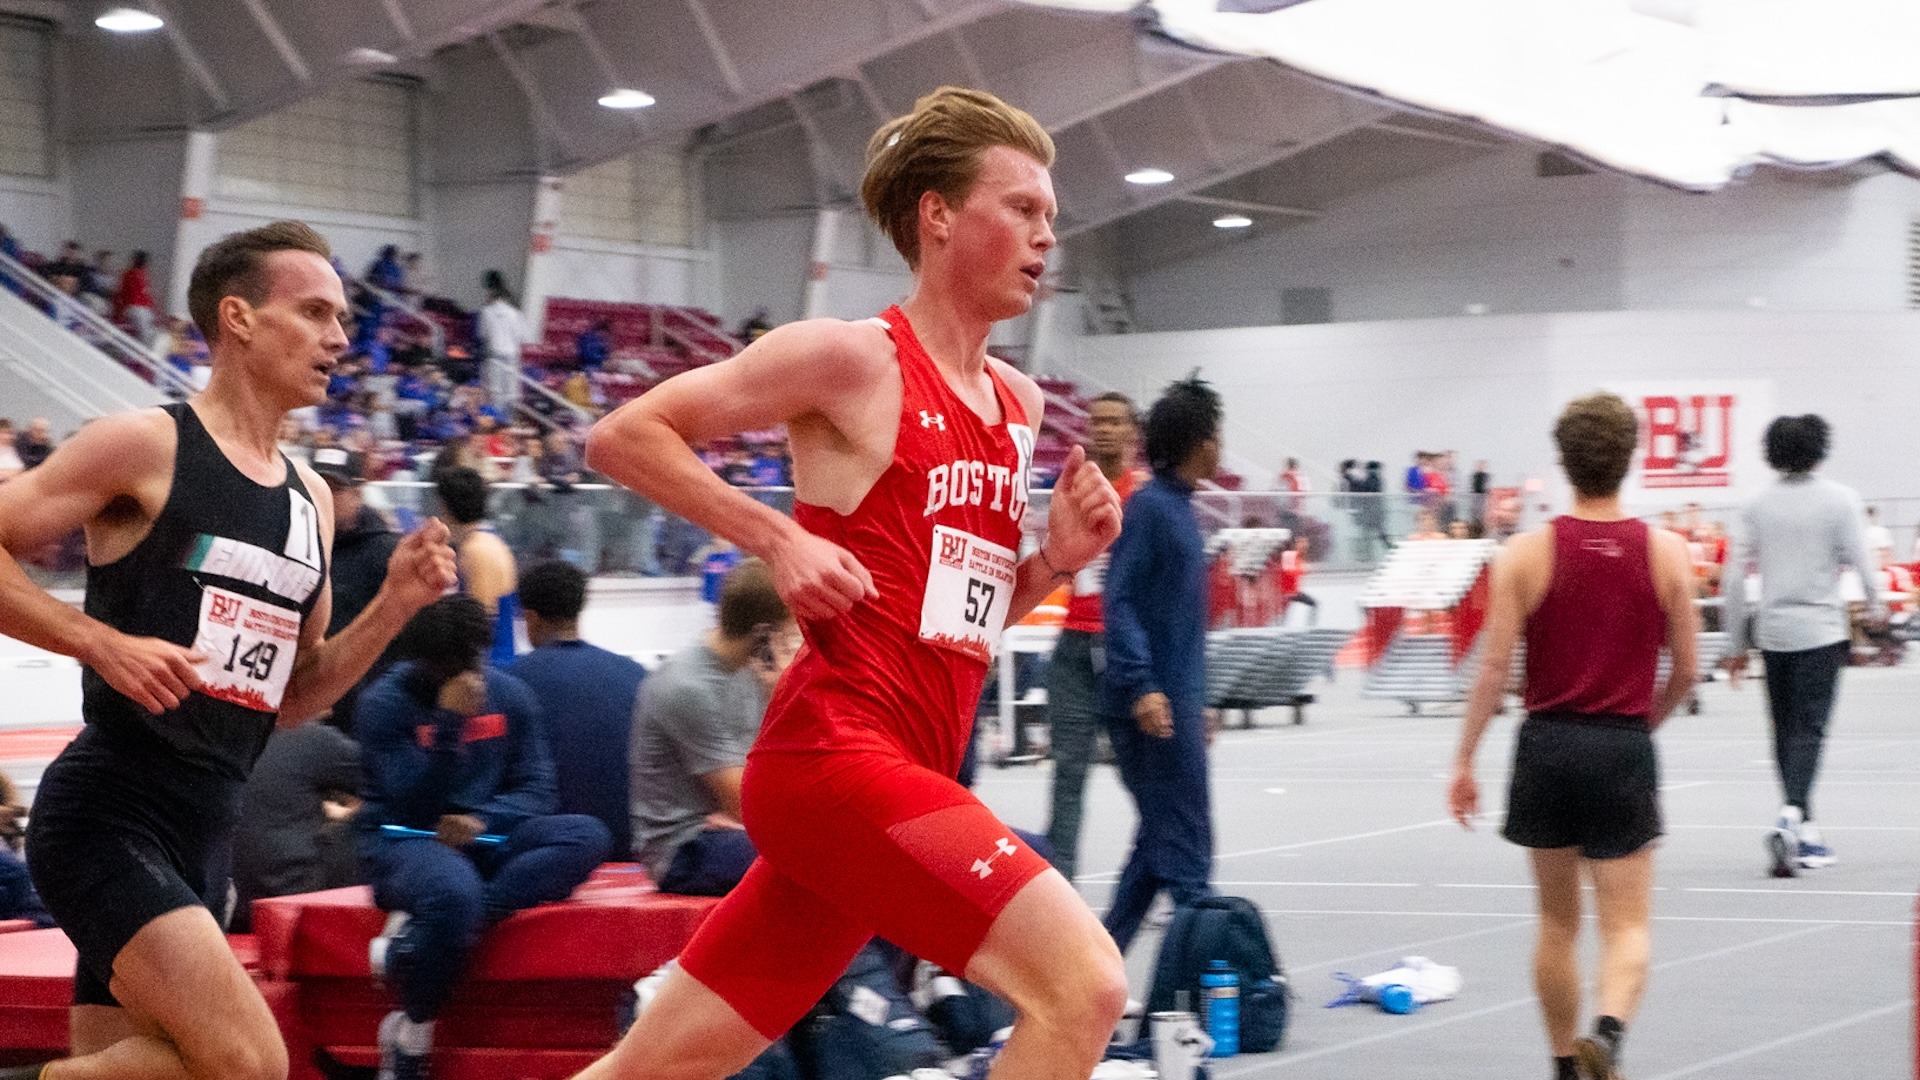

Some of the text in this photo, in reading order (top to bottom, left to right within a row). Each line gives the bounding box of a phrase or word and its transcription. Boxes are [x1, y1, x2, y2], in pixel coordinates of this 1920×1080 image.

[1643, 395, 1733, 469] BU
[923, 459, 1027, 523] BOSTO
[300, 502, 311, 560] 1
[940, 532, 968, 564] BU
[964, 577, 995, 628] 57
[224, 634, 278, 681] 149
